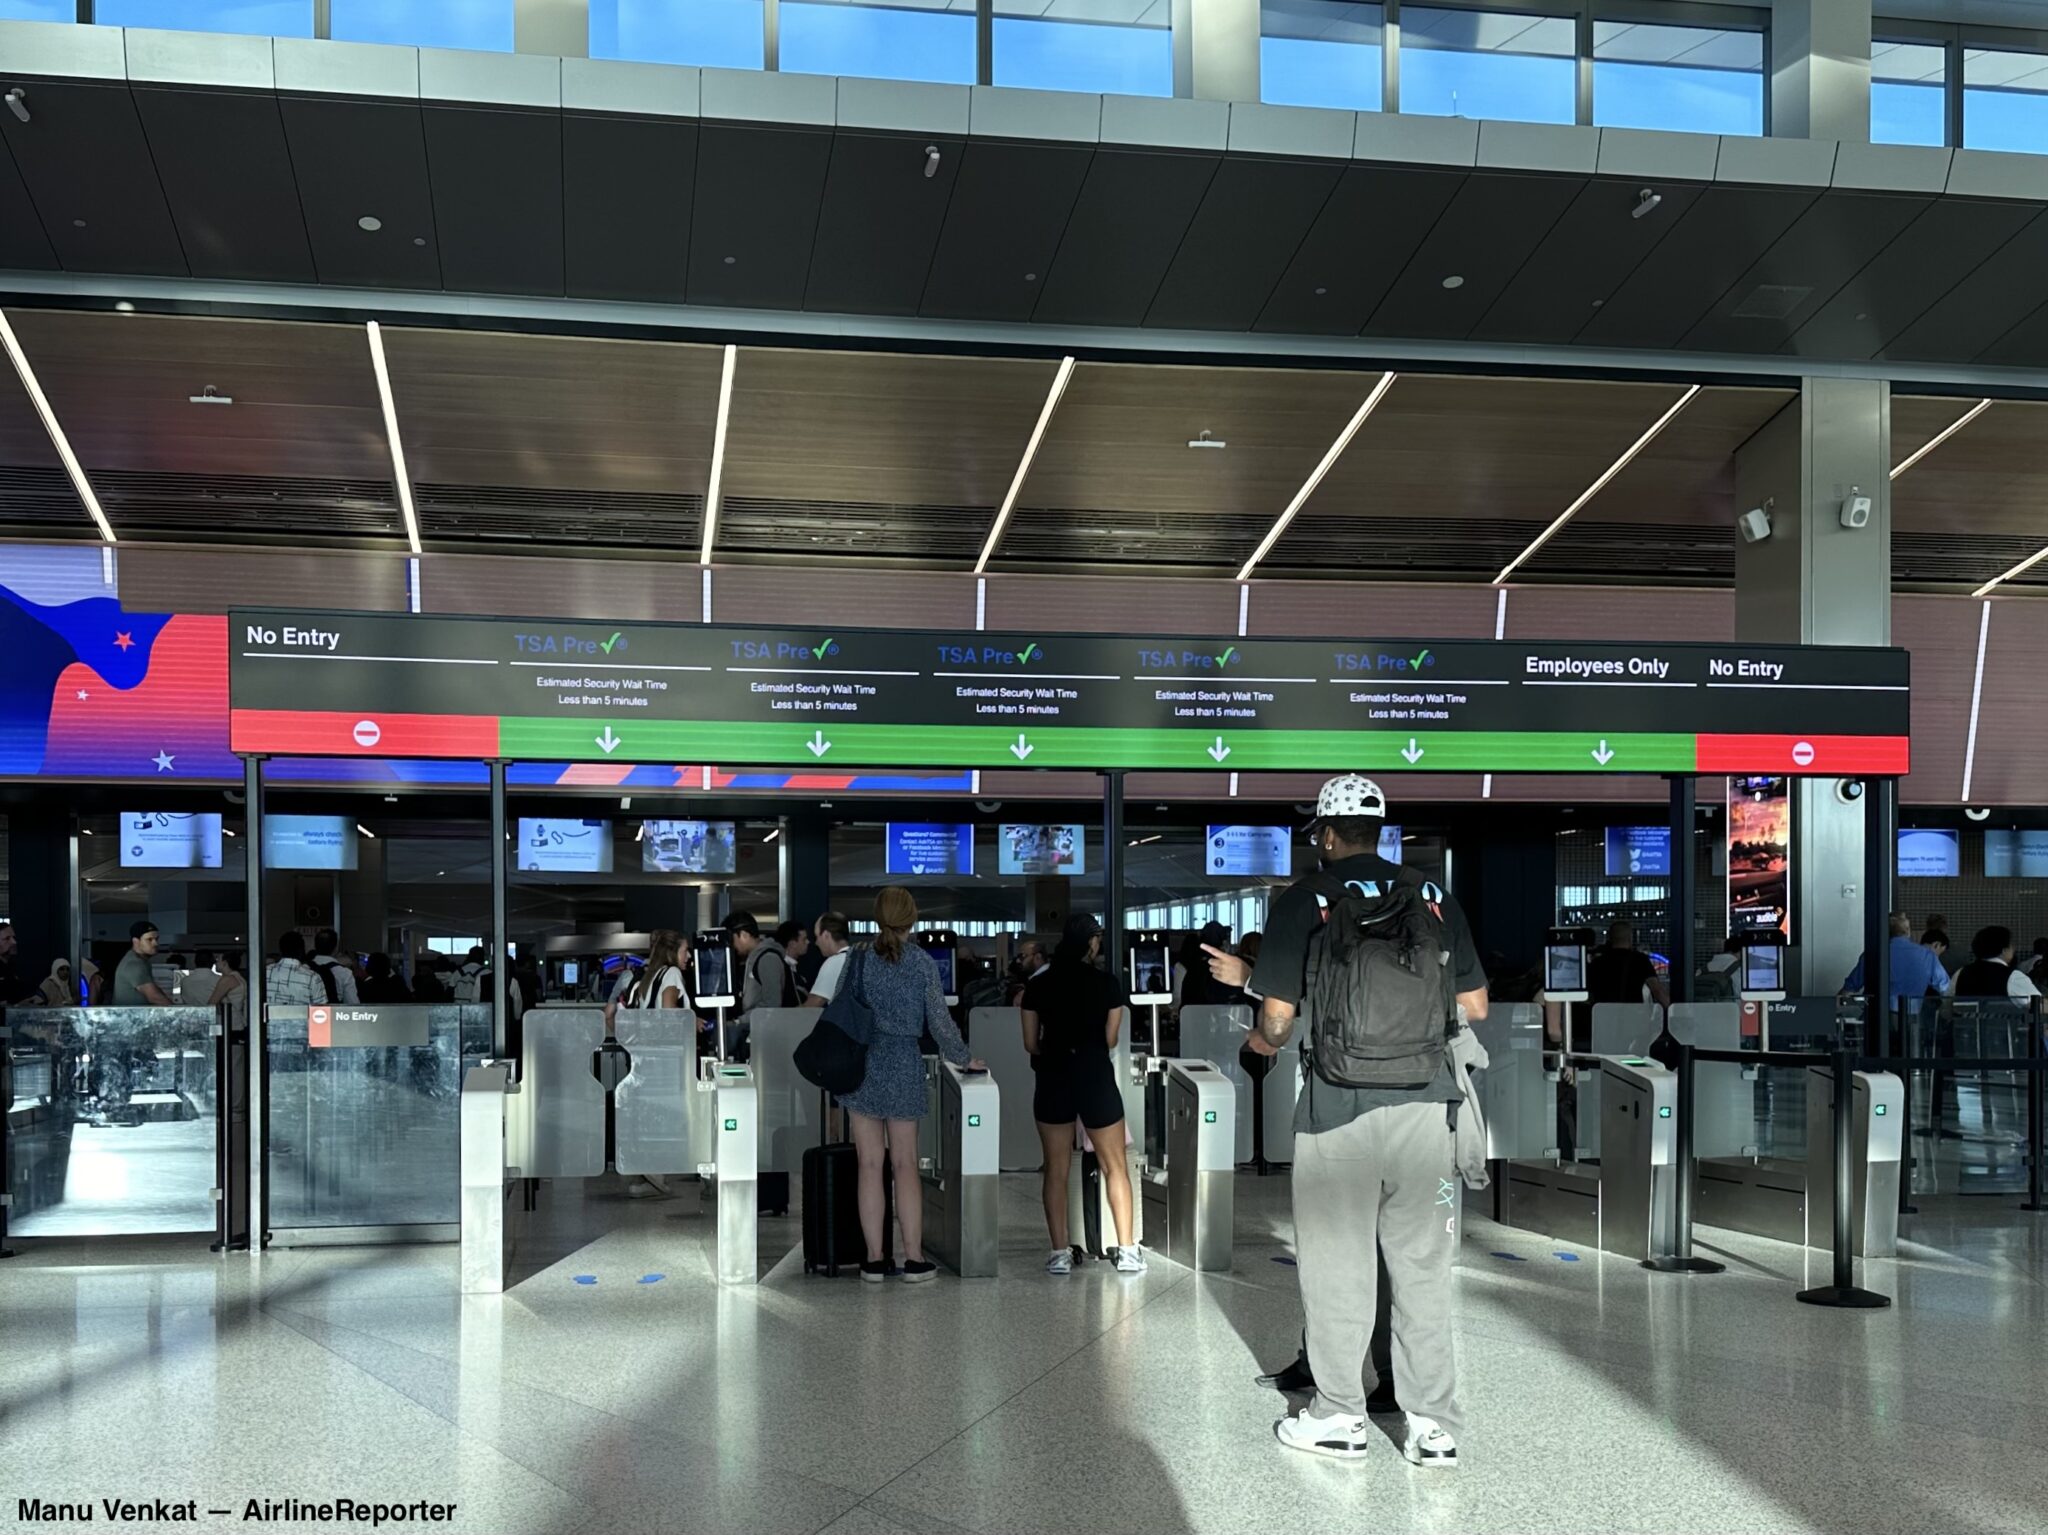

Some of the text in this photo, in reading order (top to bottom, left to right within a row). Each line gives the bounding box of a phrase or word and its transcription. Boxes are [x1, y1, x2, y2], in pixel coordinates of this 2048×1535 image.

[247, 626, 340, 649] No Entry
[515, 634, 557, 653] TSA
[731, 640, 771, 659] TSA
[938, 645, 977, 664] TSA
[1138, 649, 1177, 667] TSA
[1334, 653, 1372, 670] TSA
[1526, 656, 1670, 679] Employees Only
[1710, 659, 1784, 681] No Entry
[536, 676, 668, 691] Estimated Security Wait Time
[750, 682, 876, 696] Estimated Security Wait Time
[558, 694, 649, 706] Less than 5 minutes
[956, 686, 1078, 700] Estimated Security Wait Time
[1155, 690, 1274, 703] Estimated Security Wait Time
[1350, 692, 1467, 705] Estimated Security Wait Time
[771, 699, 858, 711] Less than 5 minutes
[976, 703, 1060, 714] Less than 5 minutes
[1174, 707, 1256, 718] Less than 5 minutes
[1369, 709, 1449, 719] Less than 5 minutes
[1775, 1003, 1796, 1014] Entry
[336, 1011, 378, 1023] No Entry
